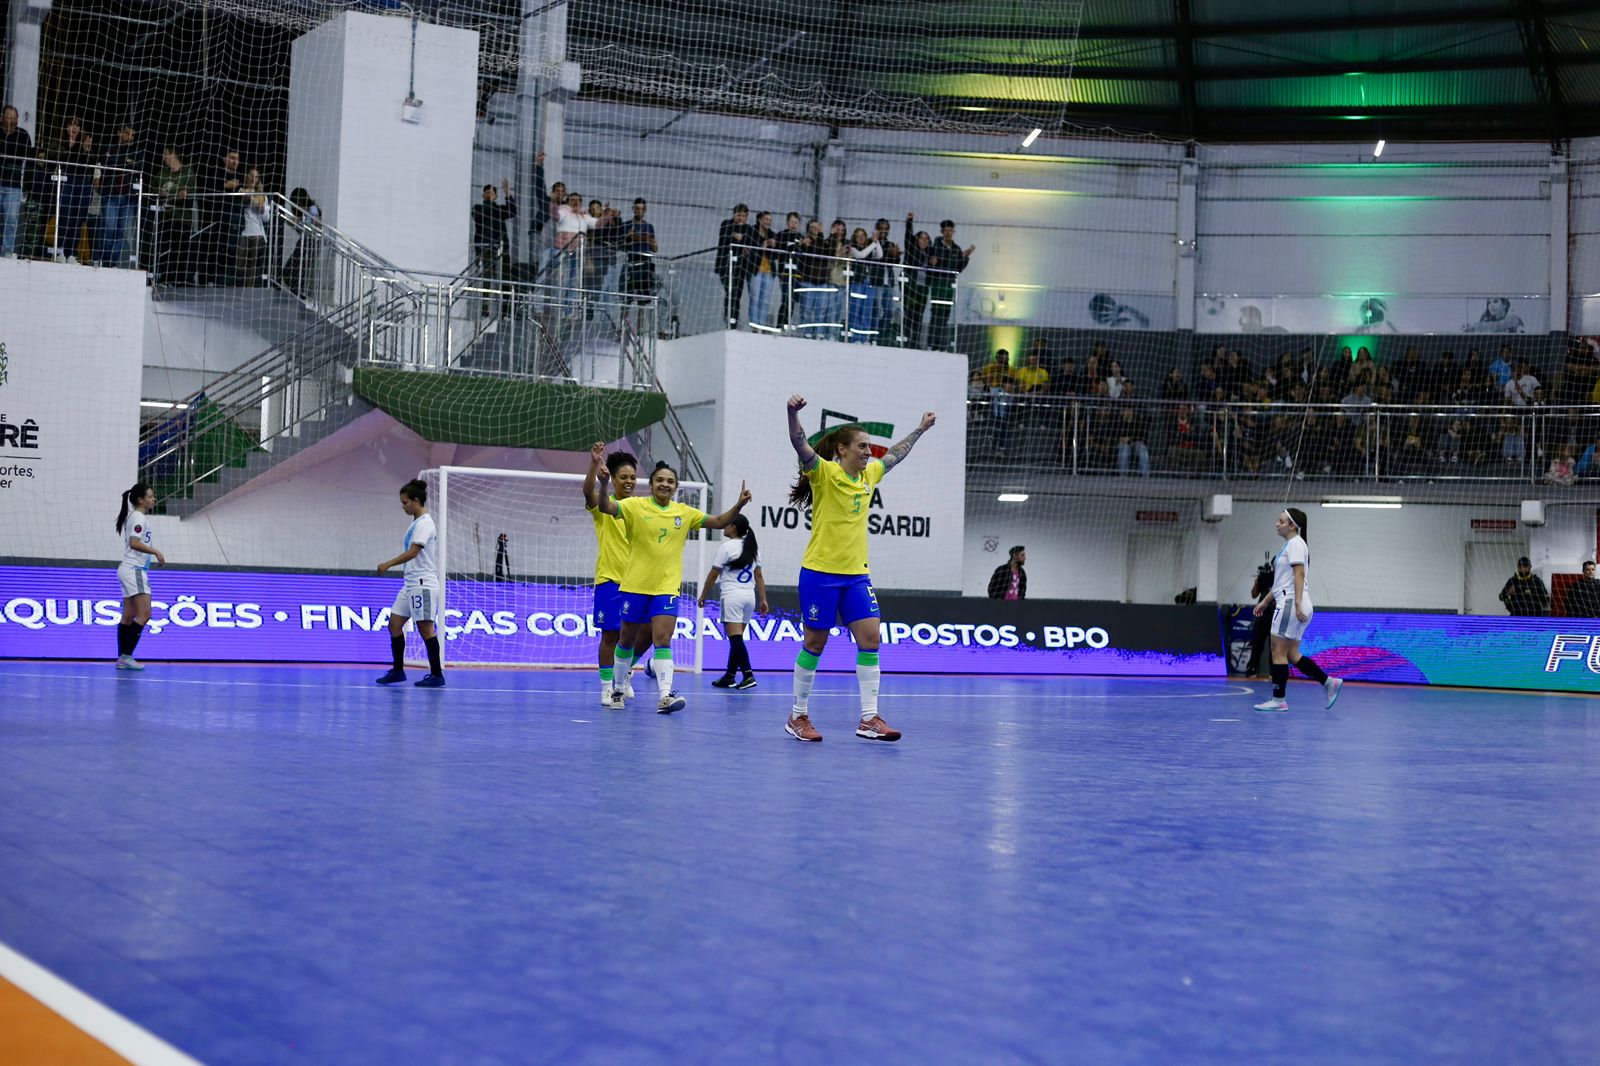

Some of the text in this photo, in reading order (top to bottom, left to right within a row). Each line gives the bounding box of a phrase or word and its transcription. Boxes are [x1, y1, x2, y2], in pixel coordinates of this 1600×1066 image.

[852, 493, 862, 514] 5
[761, 505, 799, 530] IVO
[144, 531, 153, 544] 5
[658, 528, 667, 544] 7
[411, 595, 422, 609] 13
[0, 595, 263, 635] QUISÇÕES
[301, 604, 518, 641] FINAÇAS
[1043, 626, 1109, 649] BPO
